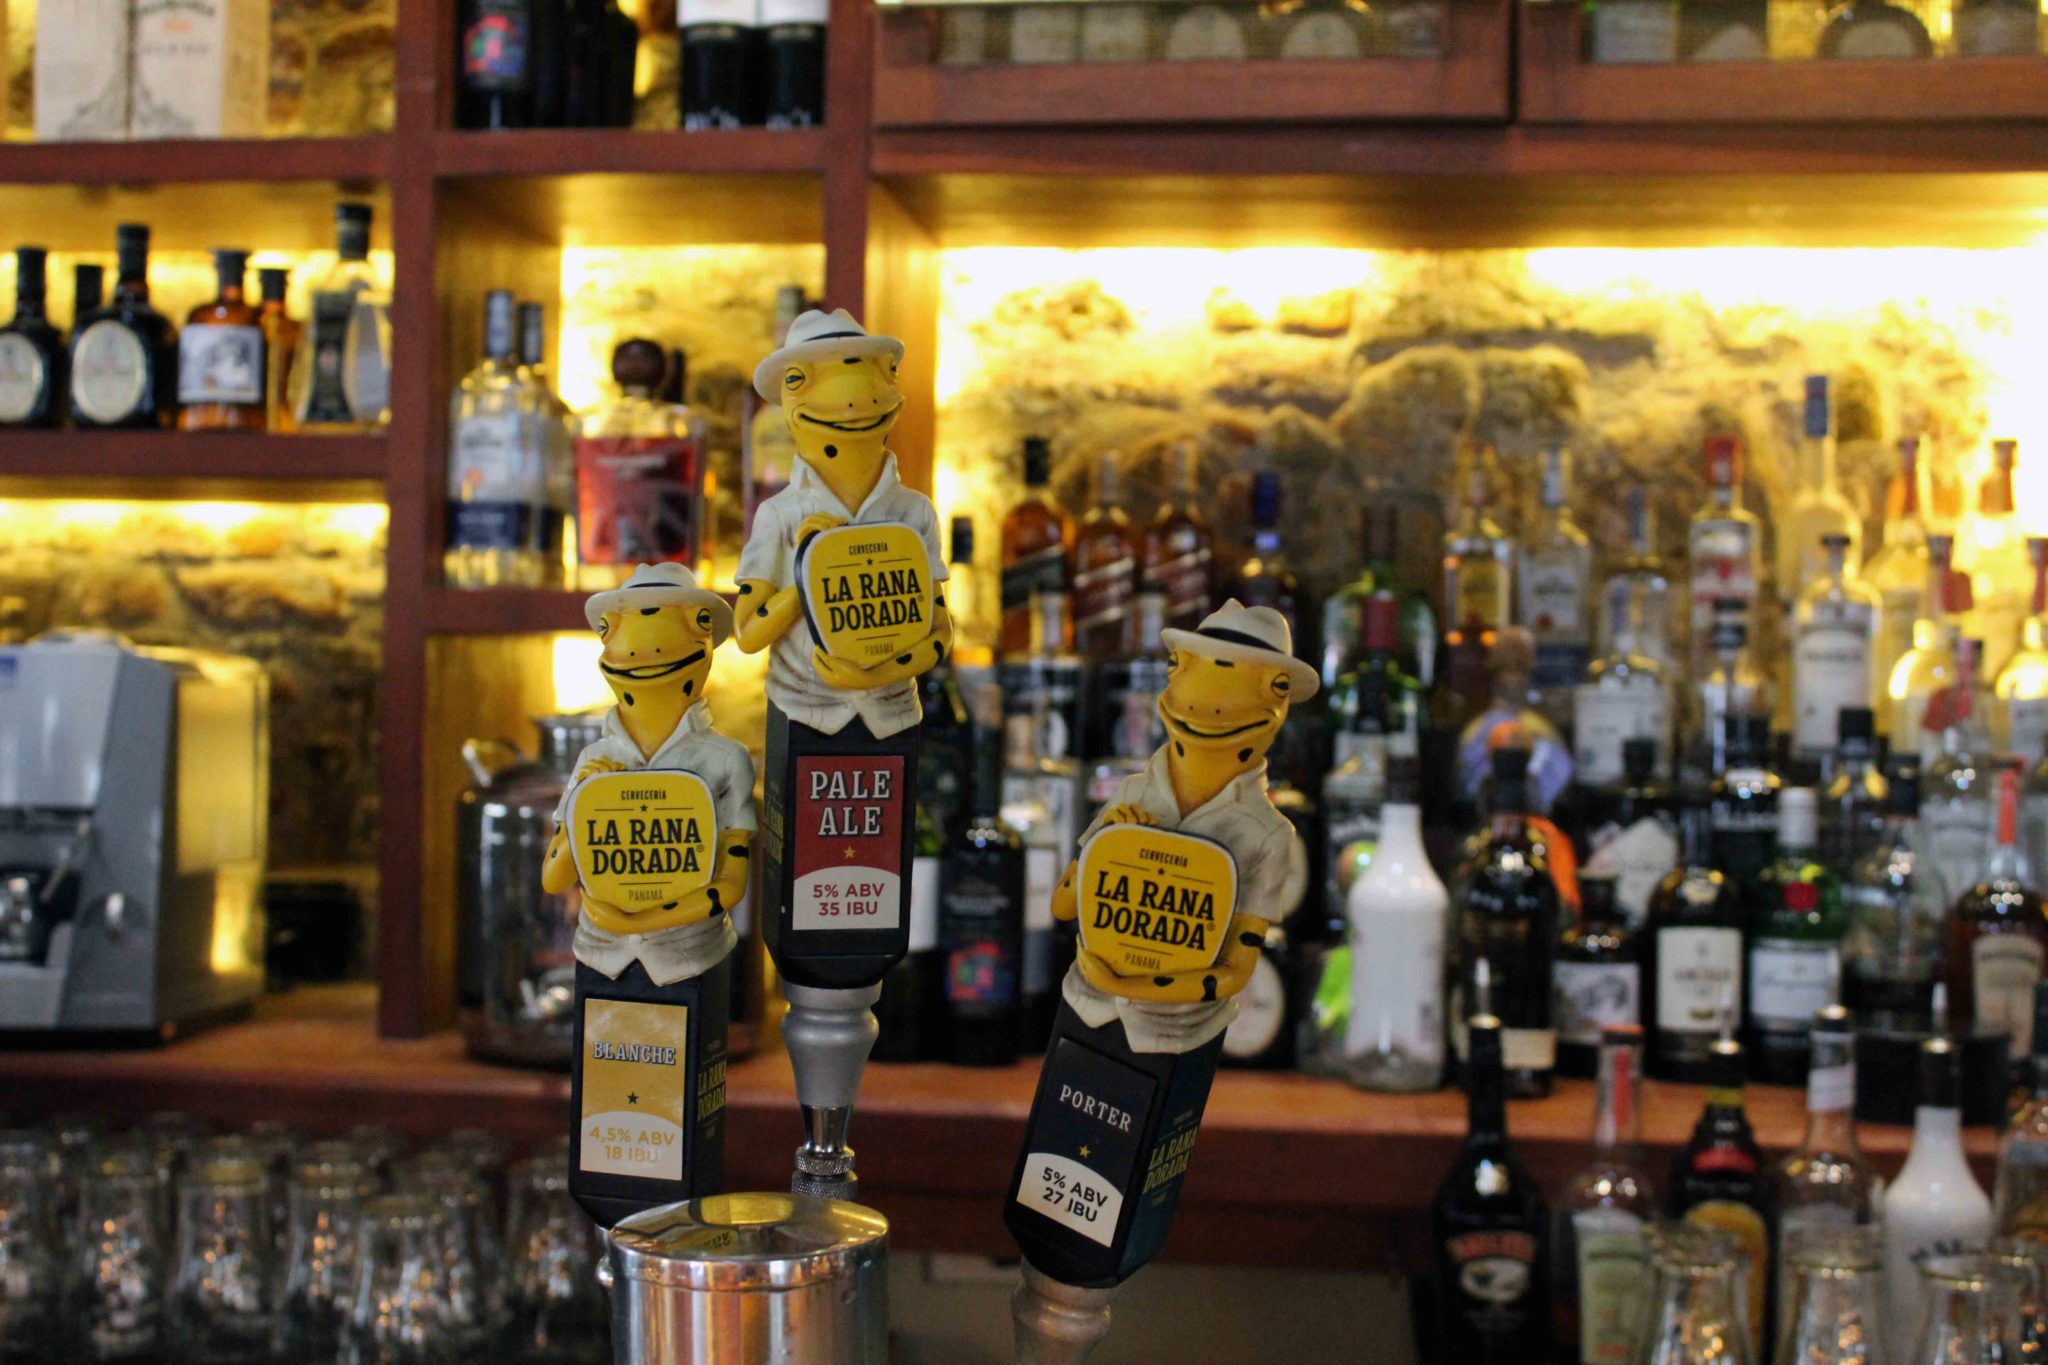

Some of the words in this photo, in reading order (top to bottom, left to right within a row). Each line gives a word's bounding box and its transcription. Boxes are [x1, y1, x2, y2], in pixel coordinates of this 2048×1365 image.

[848, 541, 888, 556] CERVECERÍA
[821, 576, 854, 604] LA
[858, 568, 922, 600] RANA
[828, 597, 923, 633] DORADA
[620, 788, 667, 801] CERVECERÍA
[810, 770, 892, 800] PALE
[586, 819, 622, 846] LA
[629, 818, 702, 845] RANA
[817, 806, 883, 836] ALE
[592, 847, 700, 875] DORADA
[1139, 848, 1189, 868] CERVECERÍA
[813, 884, 839, 898] 5%
[845, 883, 885, 898] ABV
[1095, 870, 1130, 904] LA
[1138, 879, 1215, 921] RANA
[818, 902, 840, 916] 35
[846, 901, 878, 916] IBU
[1093, 901, 1206, 951] DORADA
[593, 1040, 677, 1066] BLANCHE
[1059, 1084, 1133, 1133] PORTER
[589, 1126, 631, 1144] 4,5%
[637, 1131, 675, 1147] ABV
[604, 1146, 622, 1160] 18
[628, 1147, 659, 1163] IBU
[1042, 1166, 1066, 1189] 5%
[1070, 1182, 1108, 1208] ABV
[1042, 1187, 1064, 1204] 27
[1067, 1199, 1098, 1223] IBU
